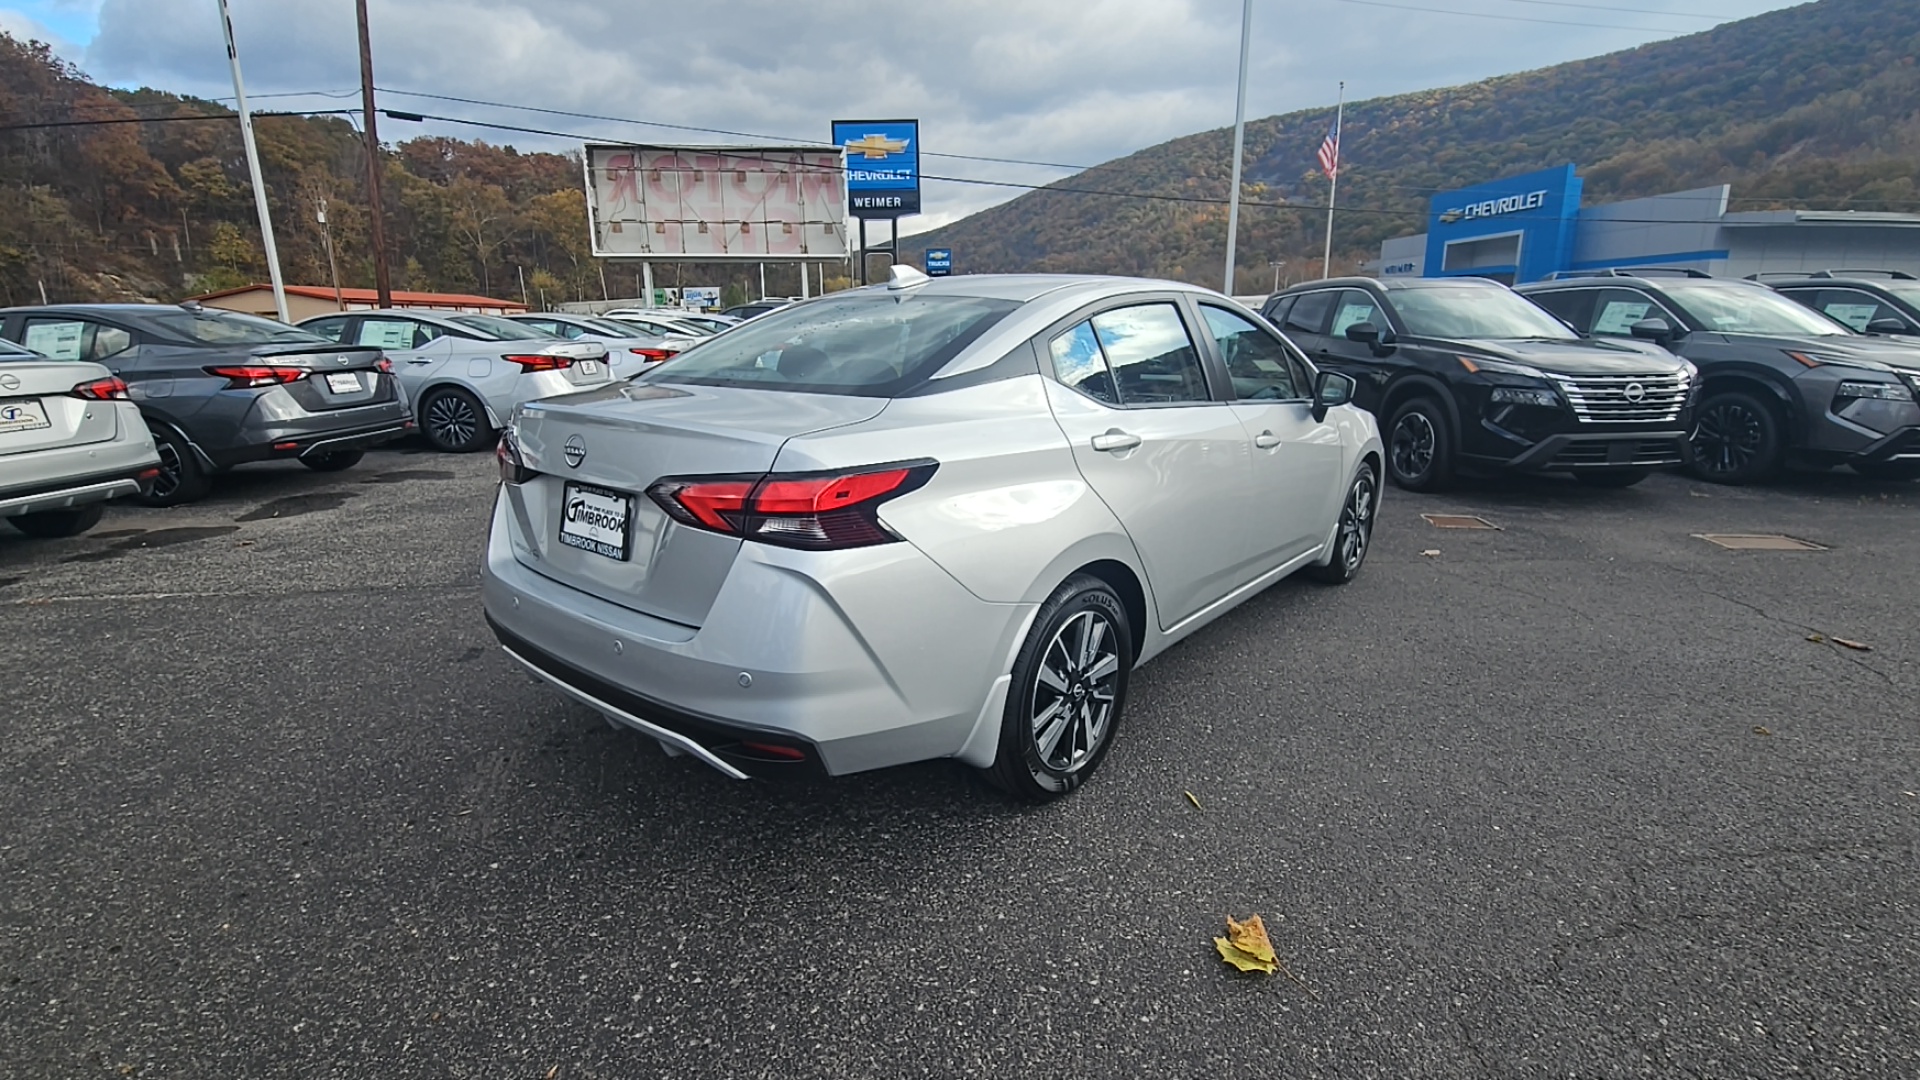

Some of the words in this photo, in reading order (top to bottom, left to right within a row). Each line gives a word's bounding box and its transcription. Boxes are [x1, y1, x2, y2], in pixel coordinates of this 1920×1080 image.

[846, 169, 912, 181] HEVROLET
[854, 196, 902, 208] WEIMER
[1464, 190, 1548, 220] CHEVROLET
[566, 497, 624, 532] TIMBROOK
[561, 533, 596, 551] TIMBROOK
[597, 544, 623, 560] NISSAN
[1082, 594, 1112, 608] SOLUS
